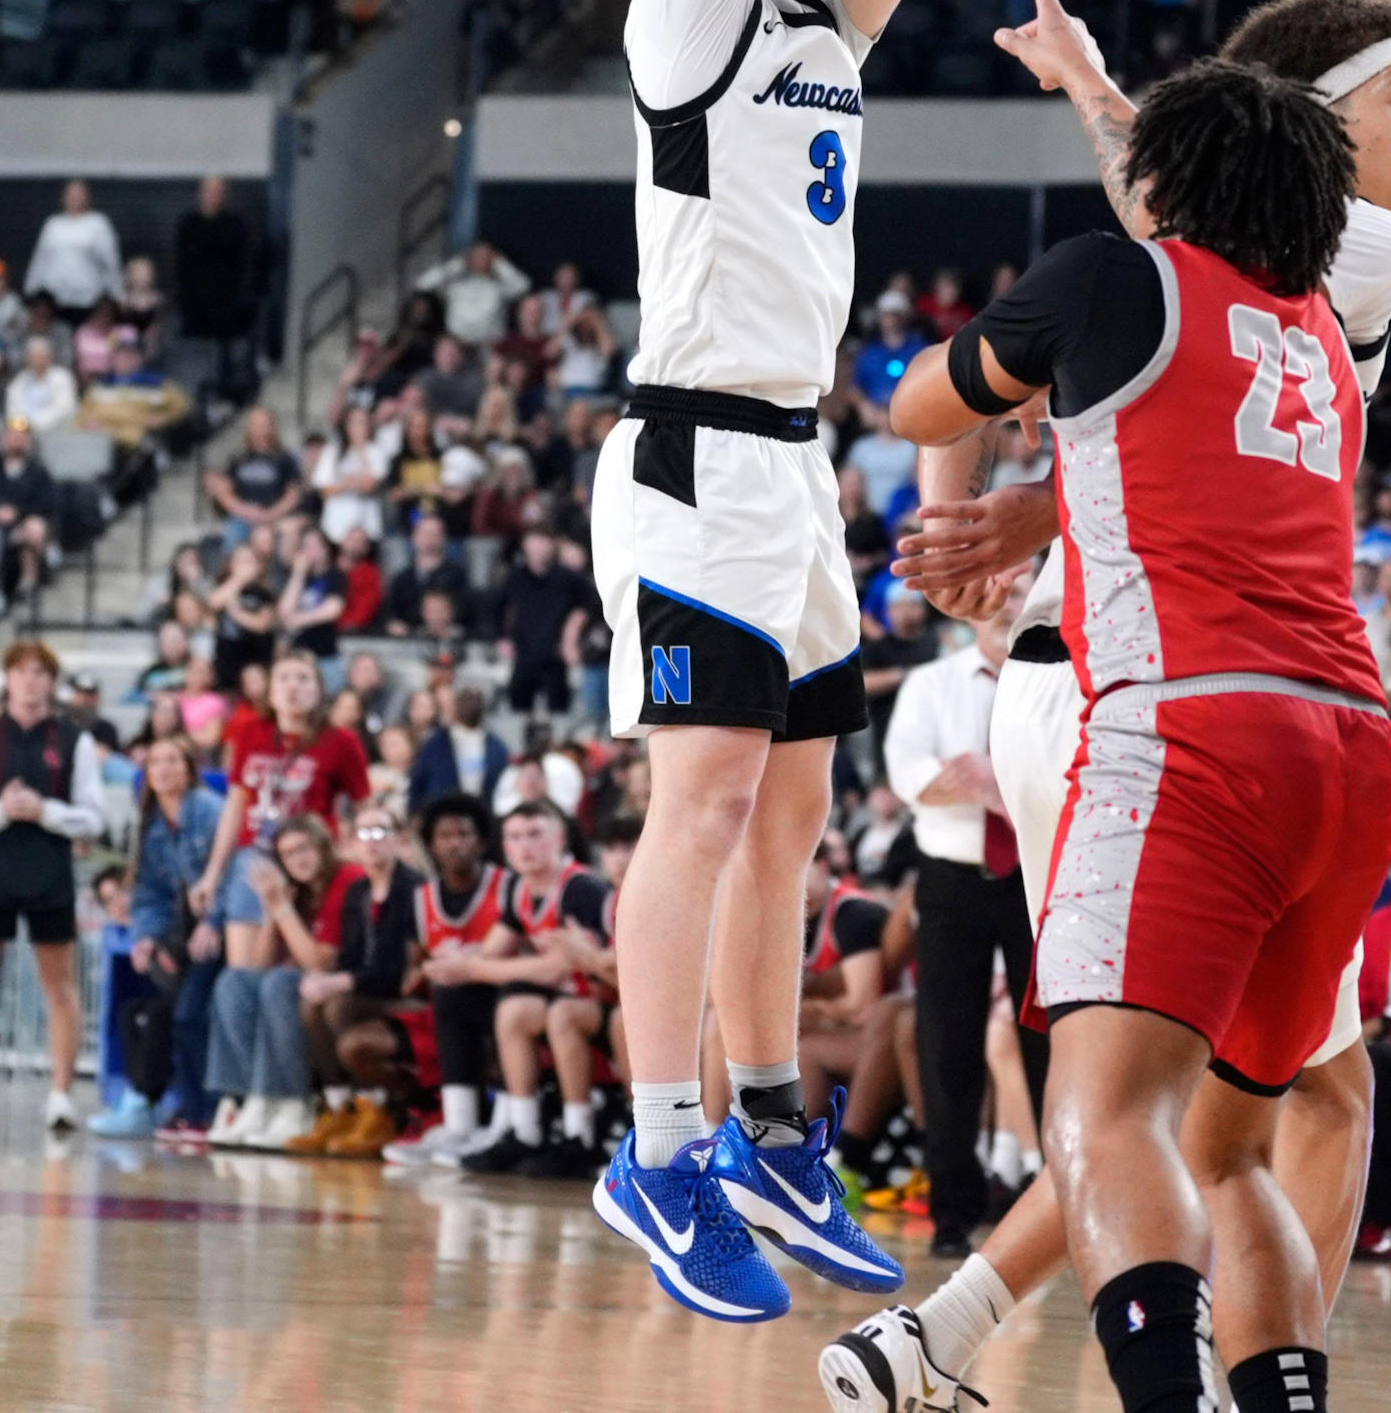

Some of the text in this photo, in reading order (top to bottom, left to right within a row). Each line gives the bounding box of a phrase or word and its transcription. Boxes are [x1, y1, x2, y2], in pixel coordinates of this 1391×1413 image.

[806, 129, 847, 226] 3
[1227, 303, 1343, 483] 23
[650, 644, 692, 705] N
